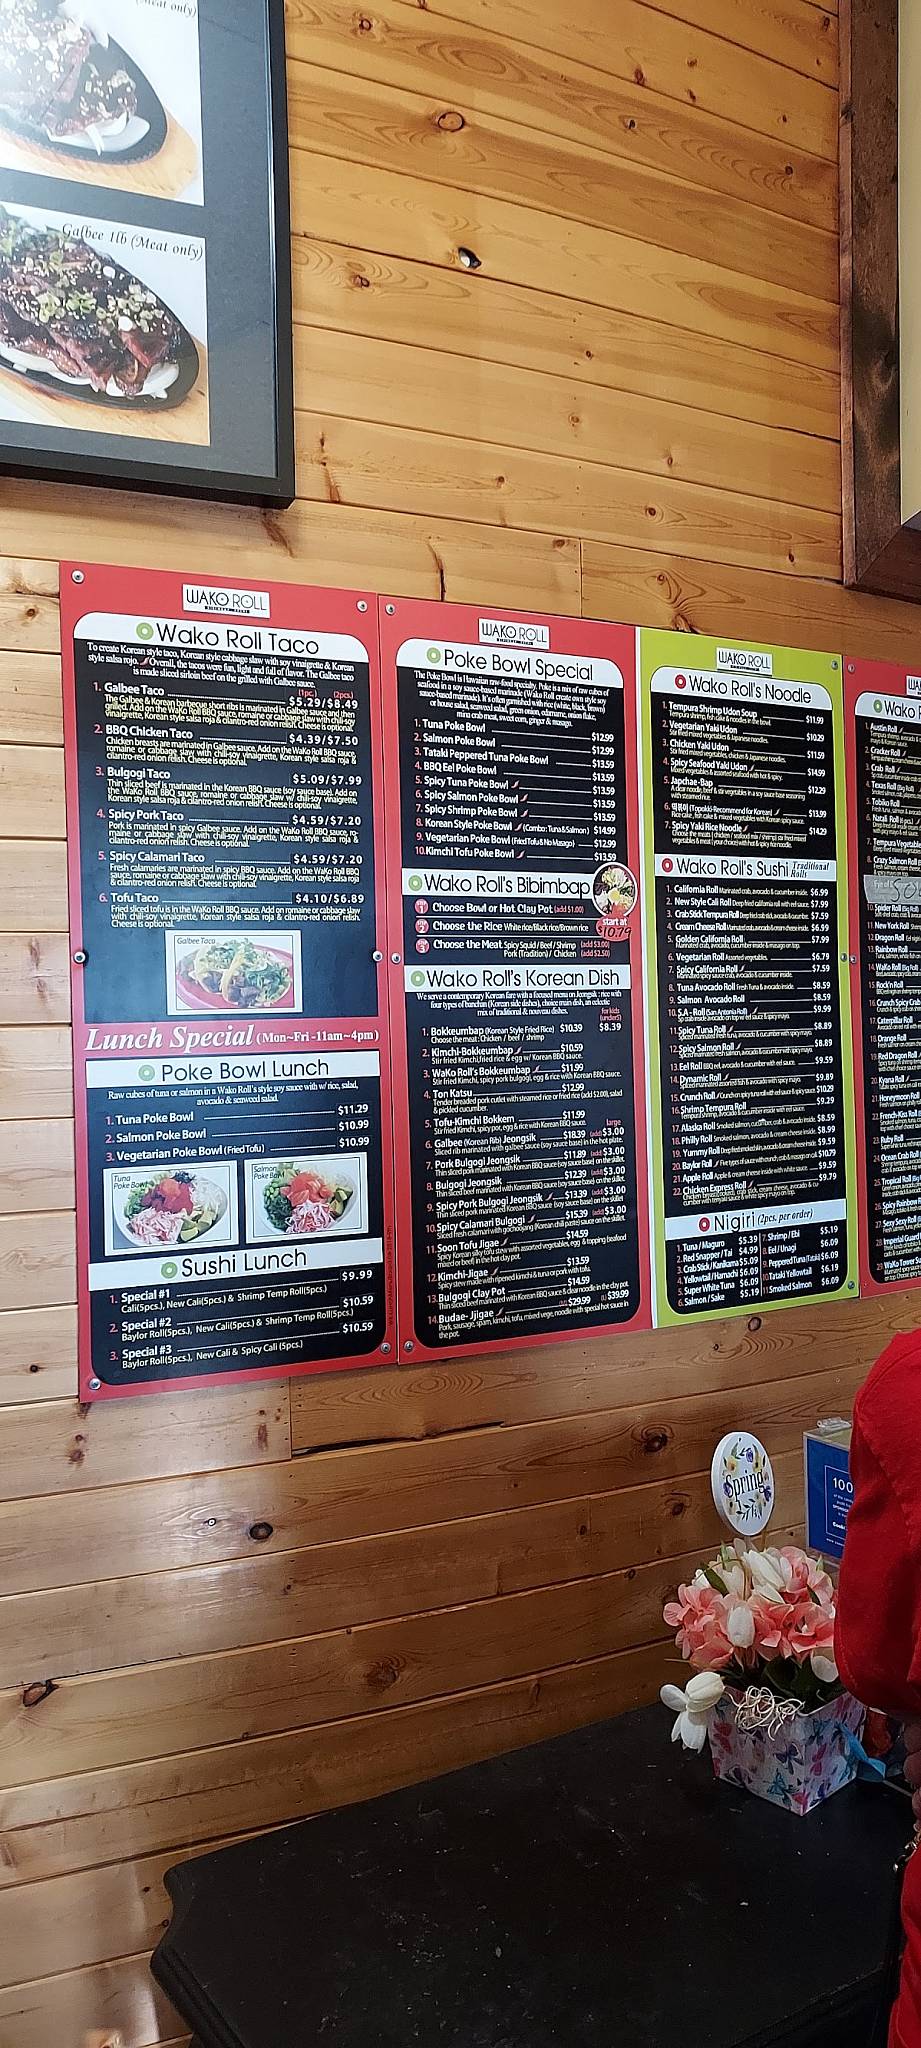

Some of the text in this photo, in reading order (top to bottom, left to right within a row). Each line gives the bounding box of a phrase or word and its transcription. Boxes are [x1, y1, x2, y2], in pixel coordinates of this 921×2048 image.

[170, 4, 197, 18] only)
[62, 223, 104, 242] Galbee
[130, 235, 168, 253] (Meat
[172, 244, 203, 261] only)
[186, 588, 229, 606] WAKO
[232, 593, 267, 610] ROLL
[156, 622, 319, 654] Wako Roll Taco
[481, 622, 516, 638] WAKO
[518, 626, 547, 643] ROLL
[444, 648, 592, 680] Poke Bowl Special
[718, 650, 746, 665] WAKO
[747, 654, 770, 669] ROLL
[104, 682, 358, 709] Galbee Taco $5.29/$8.49
[688, 674, 811, 703] Wako Roll's Noodle
[883, 700, 915, 718] Wako
[105, 724, 358, 745] BBQ Chicken Taco $4.39/$7.50
[421, 718, 614, 742] Tuna Poke Bowl $12.99
[107, 766, 361, 785] Bulgogi Taco $5.09/$7.99
[423, 761, 615, 782] BBQ Eel Poke Bowl $13.59
[108, 808, 361, 826] Spicy Pork Taco $4.59/$7.20
[109, 850, 362, 864] Spicy Calamari Taco $4.59/$7.20
[676, 857, 788, 877] Wako Roll's Sushi
[423, 873, 590, 898] Wako Roll's Bibimbap
[673, 884, 705, 893] California
[705, 885, 718, 893] Roll
[110, 892, 364, 904] Tofu Taco $4.10/$6.89
[432, 902, 465, 912] Choose
[466, 902, 486, 912] Bowl
[499, 903, 516, 913] Hot
[516, 903, 536, 914] Clay
[537, 903, 553, 913] Pot
[602, 917, 627, 926] start at
[200, 936, 215, 944] Taco
[426, 968, 619, 987] Wako Roll's Korean Dish
[83, 1026, 162, 1050] Lunch
[169, 1024, 254, 1053] Special
[162, 1058, 328, 1081] Poke Bowl Lunch
[432, 1082, 584, 1098] Ton Katsu $12.99
[115, 1103, 368, 1124] Tuna Poke Bowl $11.29
[680, 1104, 704, 1114] Shrimp
[704, 1103, 734, 1112] Tempura
[734, 1101, 746, 1111] Roll
[116, 1119, 369, 1143] Salmon Poke Bowl $10.99
[116, 1148, 171, 1162] Vegetarian
[172, 1146, 197, 1157] Poke
[198, 1144, 222, 1156] Bowl
[338, 1136, 369, 1148] $10.99
[713, 1211, 756, 1235] Nigiri
[778, 1213, 791, 1223] per
[791, 1207, 813, 1219] order)
[181, 1248, 306, 1277] Sushi Lunch
[121, 1269, 372, 1304] Special #1 $9.99
[438, 1275, 590, 1303] Bulgogi Clay Pot $14.59
[121, 1295, 373, 1332] Special #2 $10.59
[122, 1321, 373, 1359] Special #3 $10.59
[725, 1470, 764, 1510] Spring
